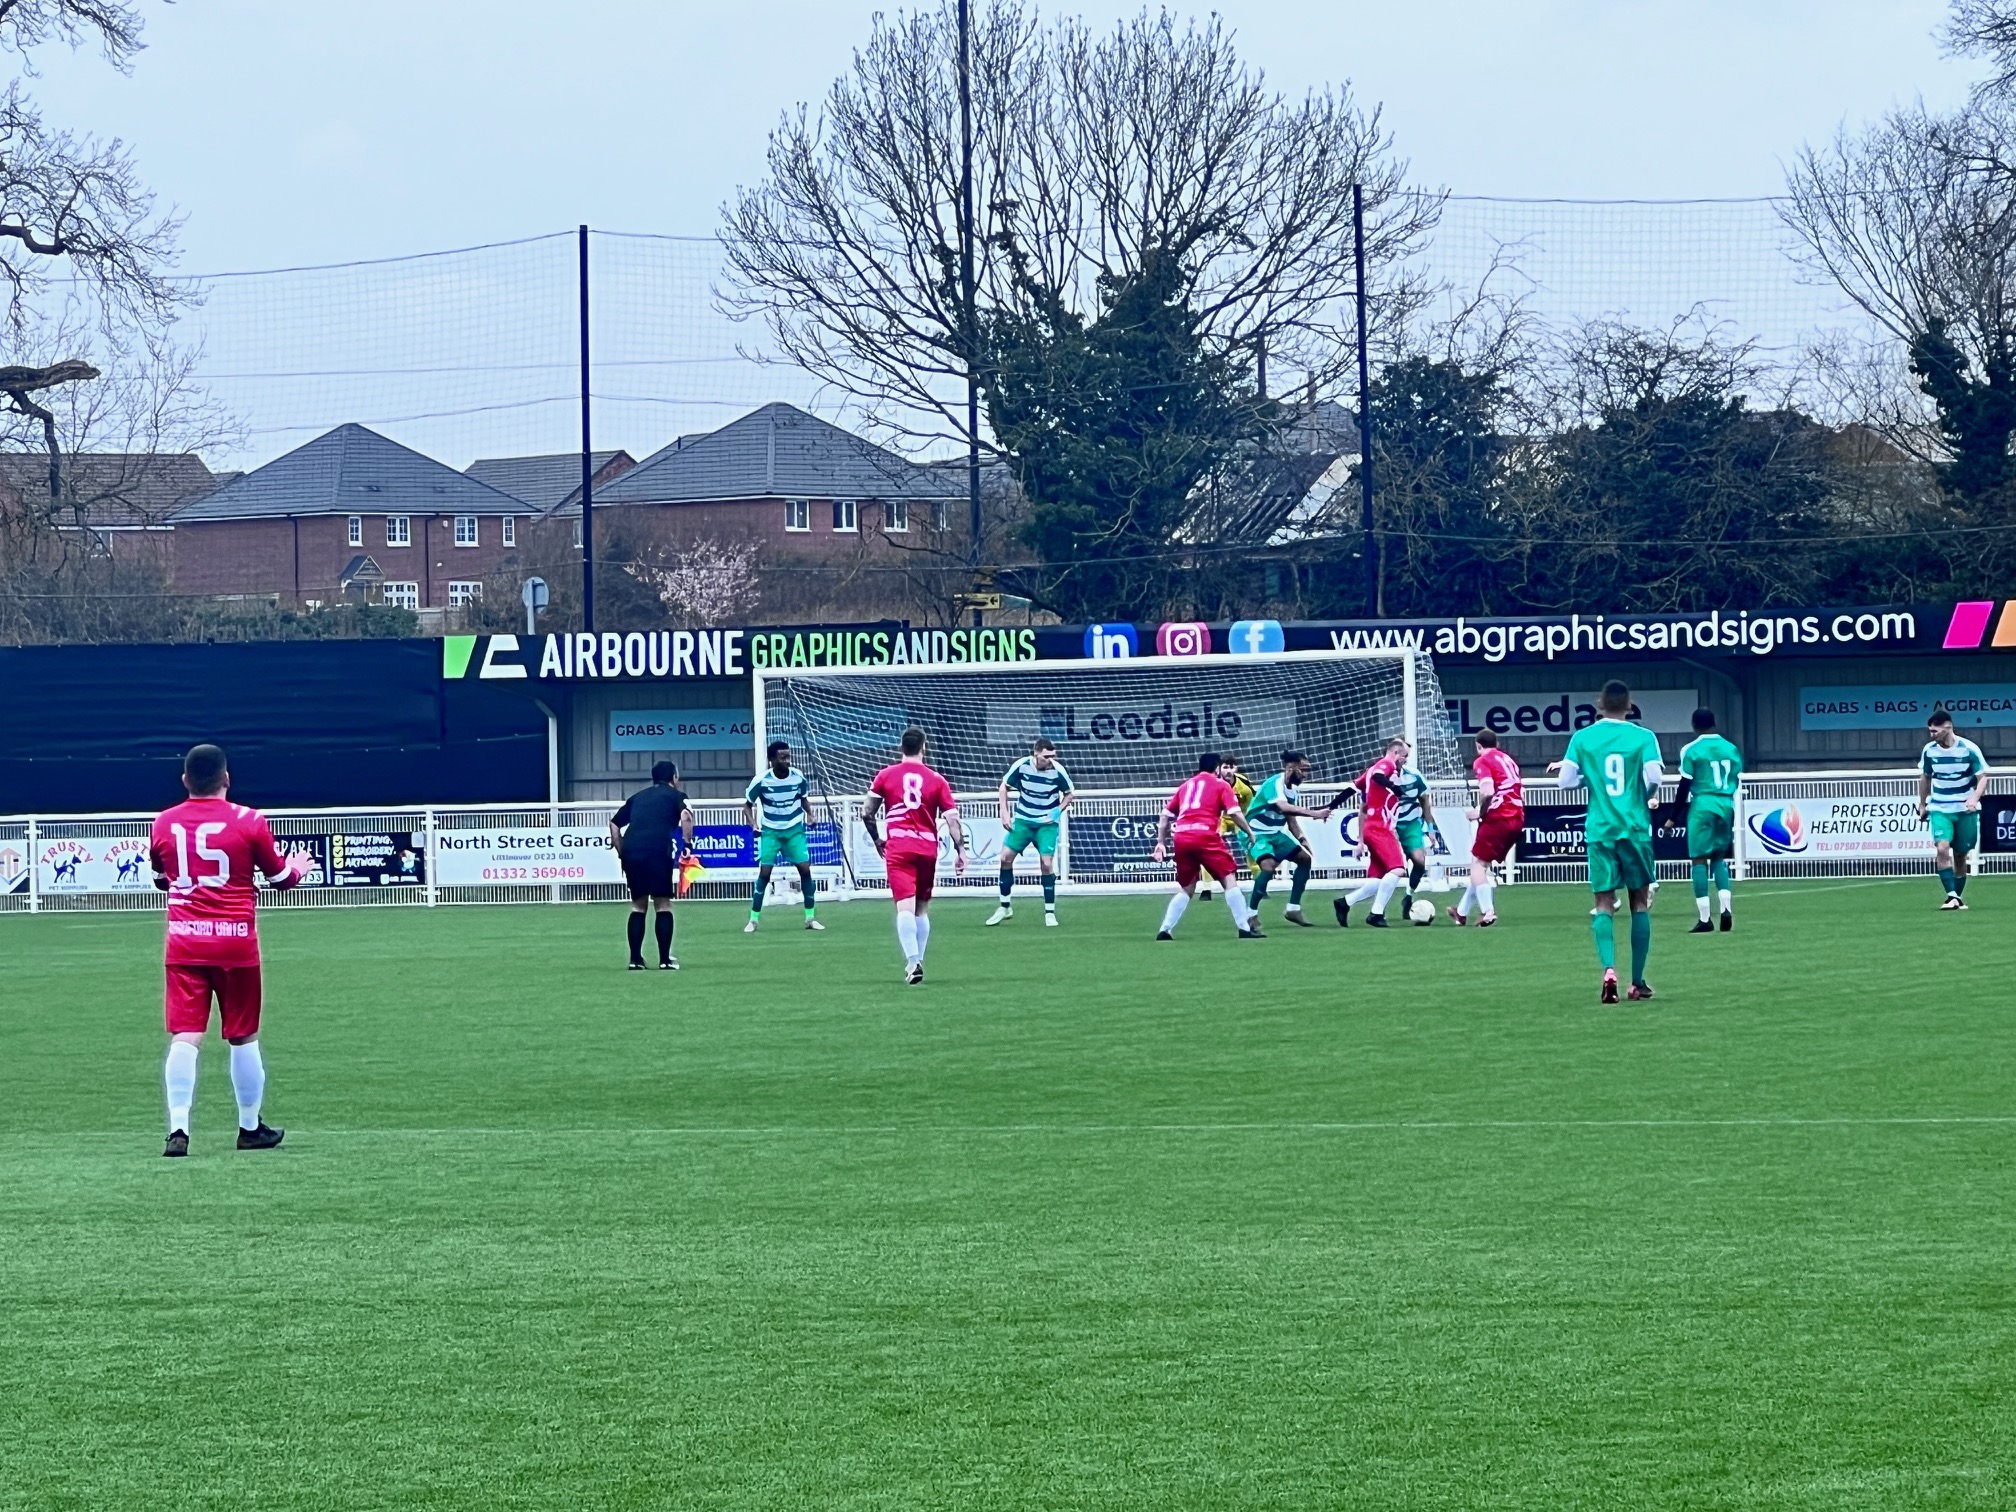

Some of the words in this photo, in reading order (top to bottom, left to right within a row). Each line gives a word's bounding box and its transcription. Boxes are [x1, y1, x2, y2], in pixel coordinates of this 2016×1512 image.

[1330, 611, 1915, 661] www.abgraphicsandsigns.com
[539, 630, 744, 678] AIRBOURNE
[751, 629, 1036, 669] GRAPHICSANDSIGNS
[1461, 695, 1641, 734] Leeda
[1805, 700, 1860, 715] GRABS
[1874, 699, 1918, 714] BAGS
[615, 724, 665, 736] GRABS
[677, 723, 717, 735] BAGS
[1066, 702, 1242, 740] Leedale
[1605, 754, 1625, 796] 9
[903, 772, 923, 810] 8
[1181, 780, 1206, 809] 11
[1112, 817, 1160, 838] Gre
[1810, 820, 1873, 834] HEATING
[41, 841, 93, 864] TRUSTY
[103, 840, 152, 863] TRUST
[170, 822, 230, 887] 15
[440, 835, 491, 850] North
[497, 834, 554, 849] Street
[482, 868, 527, 879] 01332
[532, 867, 585, 879] 369469
